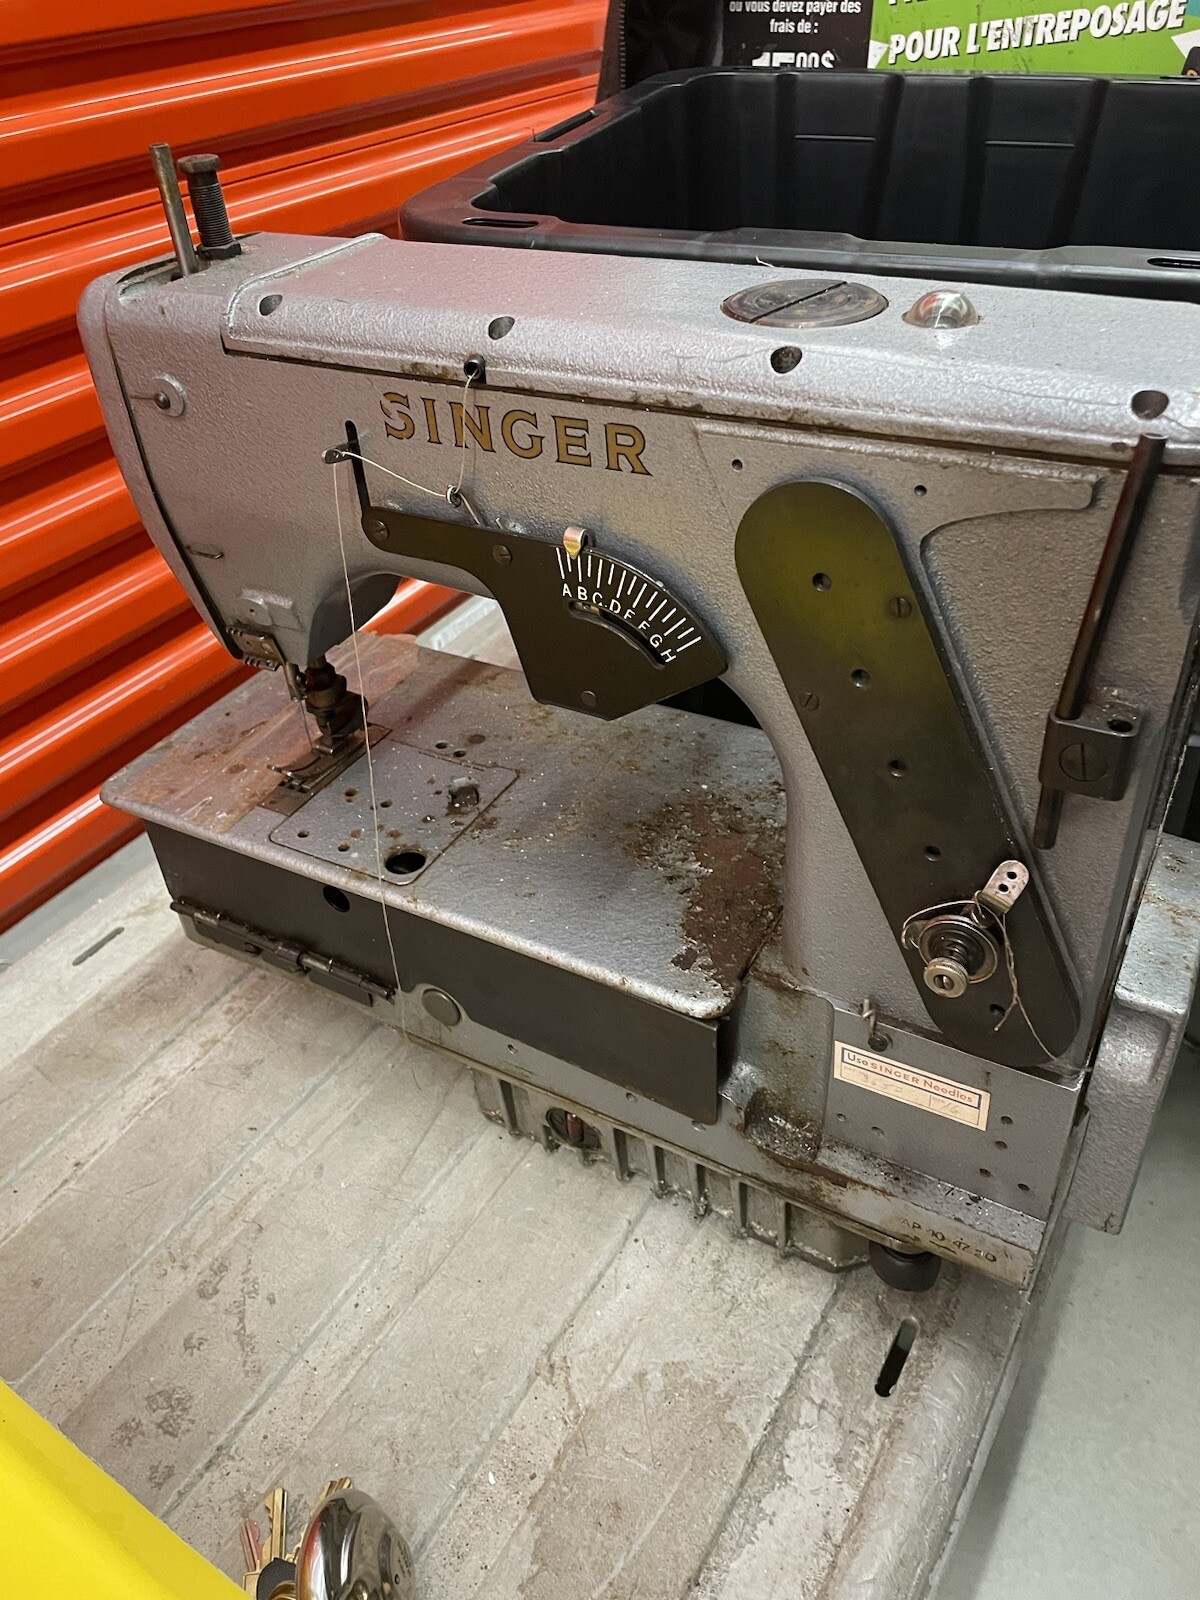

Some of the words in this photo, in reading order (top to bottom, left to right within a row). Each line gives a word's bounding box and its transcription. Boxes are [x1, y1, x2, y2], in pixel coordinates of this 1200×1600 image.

[745, 1, 771, 13] vous
[772, 0, 804, 13] devez
[805, 0, 839, 16] payer
[840, 0, 862, 13] des
[769, 18, 796, 33] frais
[797, 18, 812, 33] de
[888, 26, 961, 64] POUR
[966, 0, 1190, 55] L'ENTREPOSAGE
[380, 391, 653, 477] SINGER
[562, 583, 572, 597] A
[577, 586, 588, 600] B
[609, 599, 622, 614] D
[650, 633, 663, 649] G
[661, 648, 677, 663] H
[847, 1052, 869, 1067] Use
[870, 1061, 920, 1086] SINGER
[923, 1079, 973, 1104] Needles
